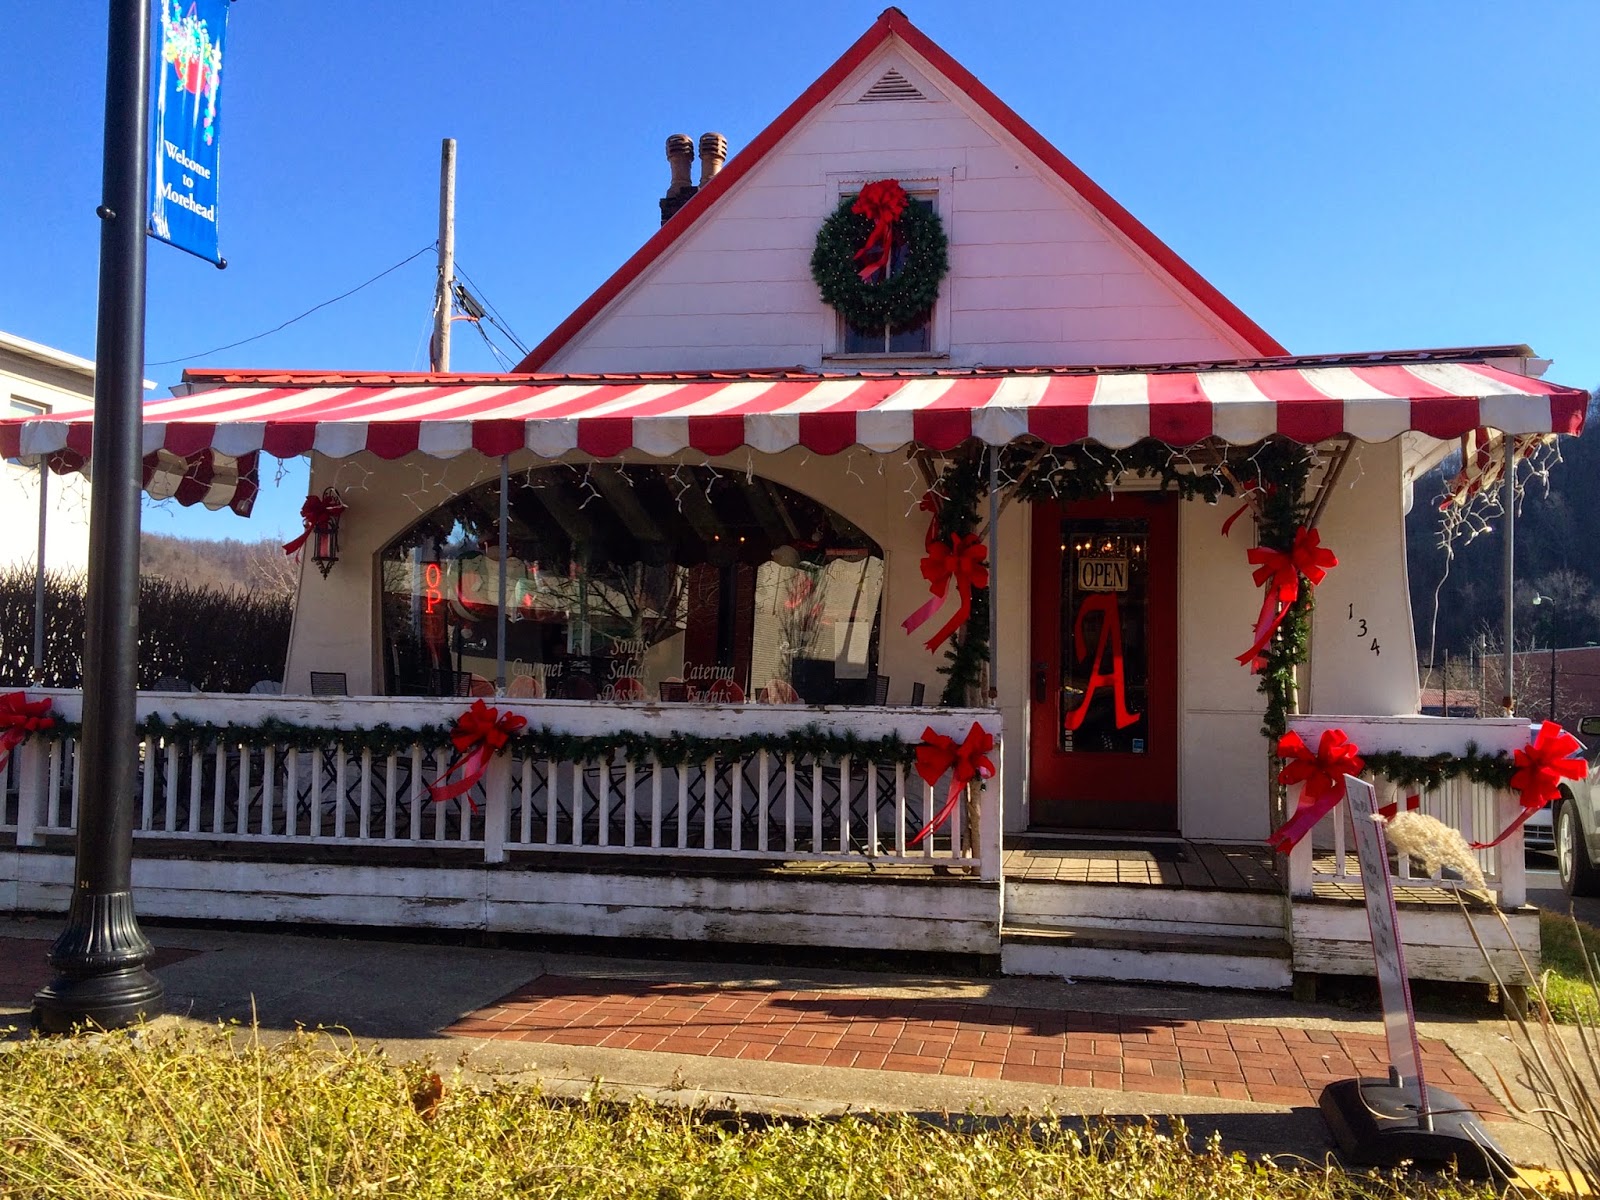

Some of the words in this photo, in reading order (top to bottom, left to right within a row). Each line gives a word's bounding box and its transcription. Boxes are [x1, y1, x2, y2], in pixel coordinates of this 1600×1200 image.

[164, 139, 211, 179] Welcome
[182, 174, 194, 188] to
[160, 183, 215, 222] Morehead
[1082, 561, 1125, 587] OPEN
[1348, 602, 1381, 657] 134
[610, 636, 650, 660] Soups
[1064, 592, 1141, 730] A
[511, 658, 564, 678] Gourmet
[607, 657, 650, 680] Salads
[682, 661, 736, 687] Catering
[686, 685, 732, 704] Events
